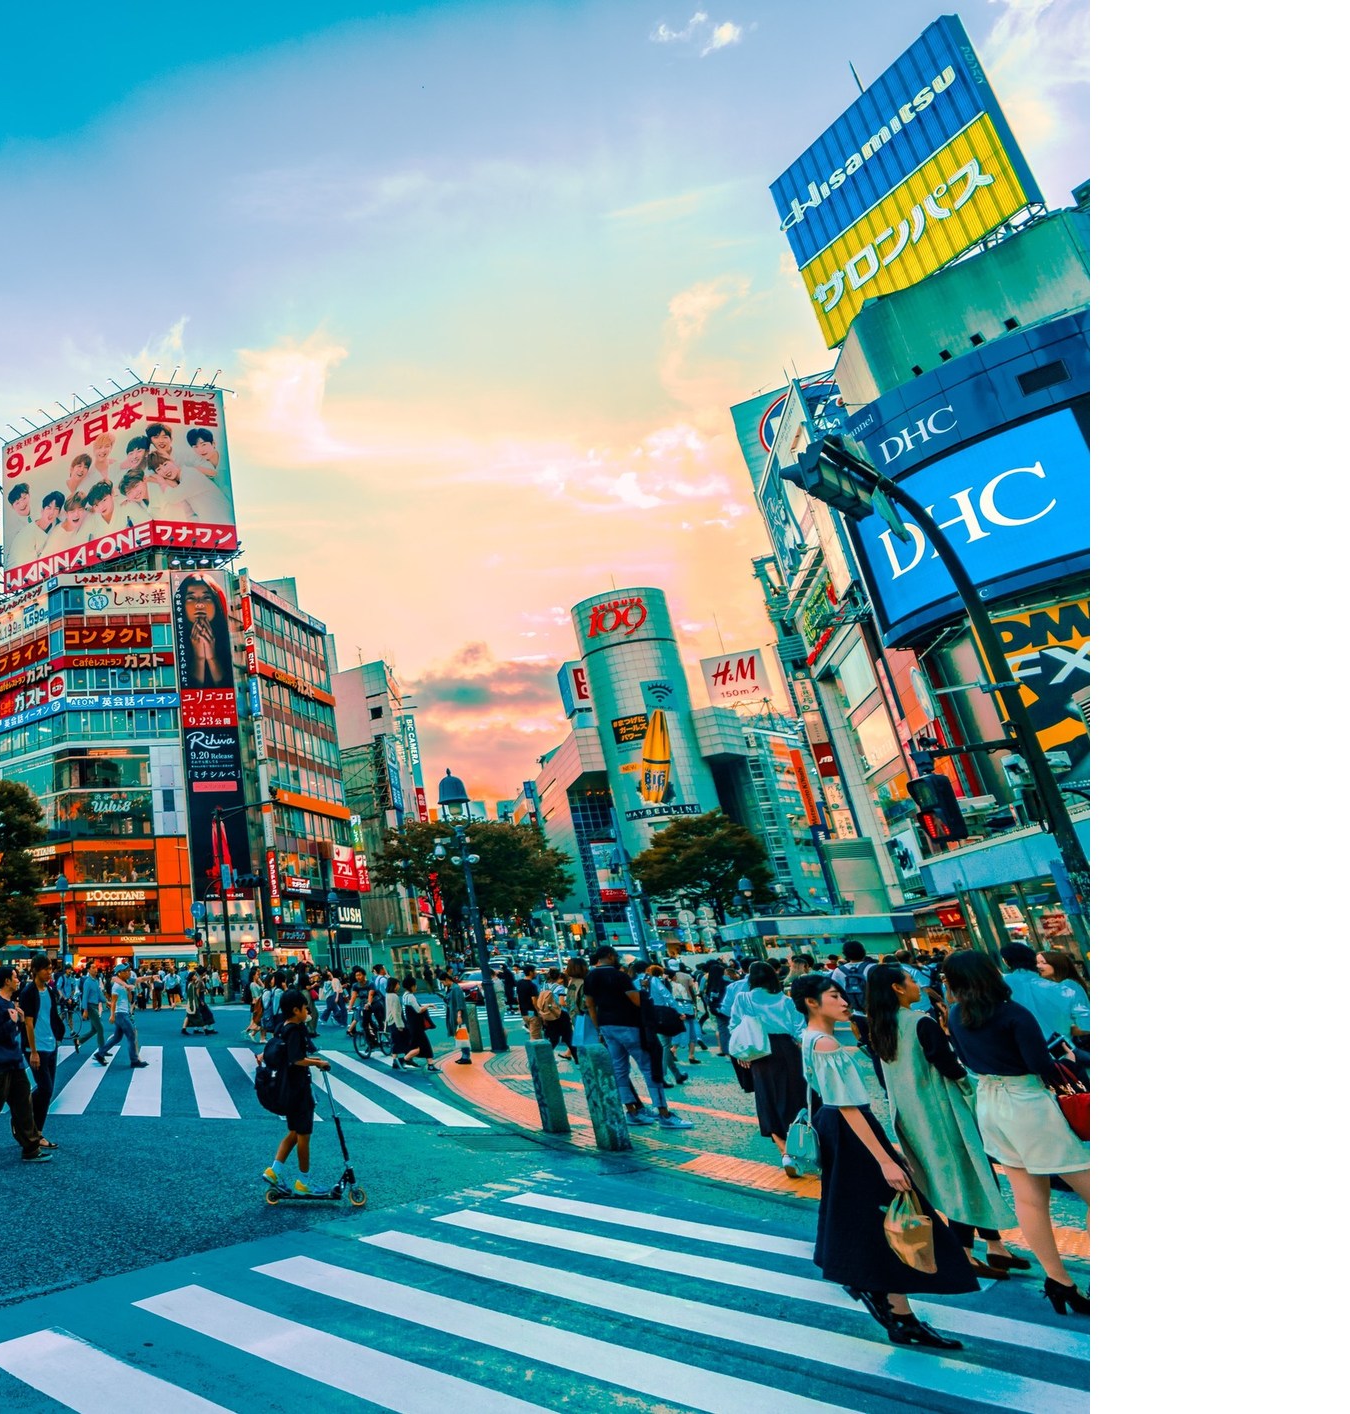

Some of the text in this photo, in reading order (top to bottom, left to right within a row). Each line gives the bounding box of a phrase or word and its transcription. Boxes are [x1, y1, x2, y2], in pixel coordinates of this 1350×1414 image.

[780, 65, 956, 231] Hisamitsu
[811, 158, 994, 312] サロンパス
[5, 397, 218, 479] 9.27 日本上陸
[878, 405, 957, 465] DHC
[878, 461, 1057, 580] DHC
[155, 525, 233, 544] ワナワン
[75, 571, 163, 584] しゃぶしゃぶバイキング
[113, 588, 167, 606] しゃぶ葉
[592, 597, 643, 613] SHIBUYA
[587, 603, 647, 638] 109
[65, 627, 149, 644] コンタクト
[0, 639, 48, 672] プライス
[124, 654, 165, 669] ガスト
[26, 663, 53, 684] ガスト
[711, 655, 755, 686] H&M
[14, 687, 47, 713] ガスト
[71, 698, 95, 706] AEON
[102, 695, 177, 707] 英会話イーオン
[182, 690, 234, 704] ユリゴコロ
[720, 689, 749, 698] 150m
[4, 706, 50, 729] 英会話イーオン
[186, 731, 236, 750] Rihwa
[405, 718, 420, 765] BIC CAMERA
[190, 751, 209, 760] 9.20
[188, 770, 241, 779] 「ミチシルベ」
[622, 764, 637, 772] NEW
[645, 772, 666, 787] BIG
[337, 862, 353, 876] アコム
[86, 890, 145, 901] L'OCCITANE
[337, 906, 362, 923] LUSH
